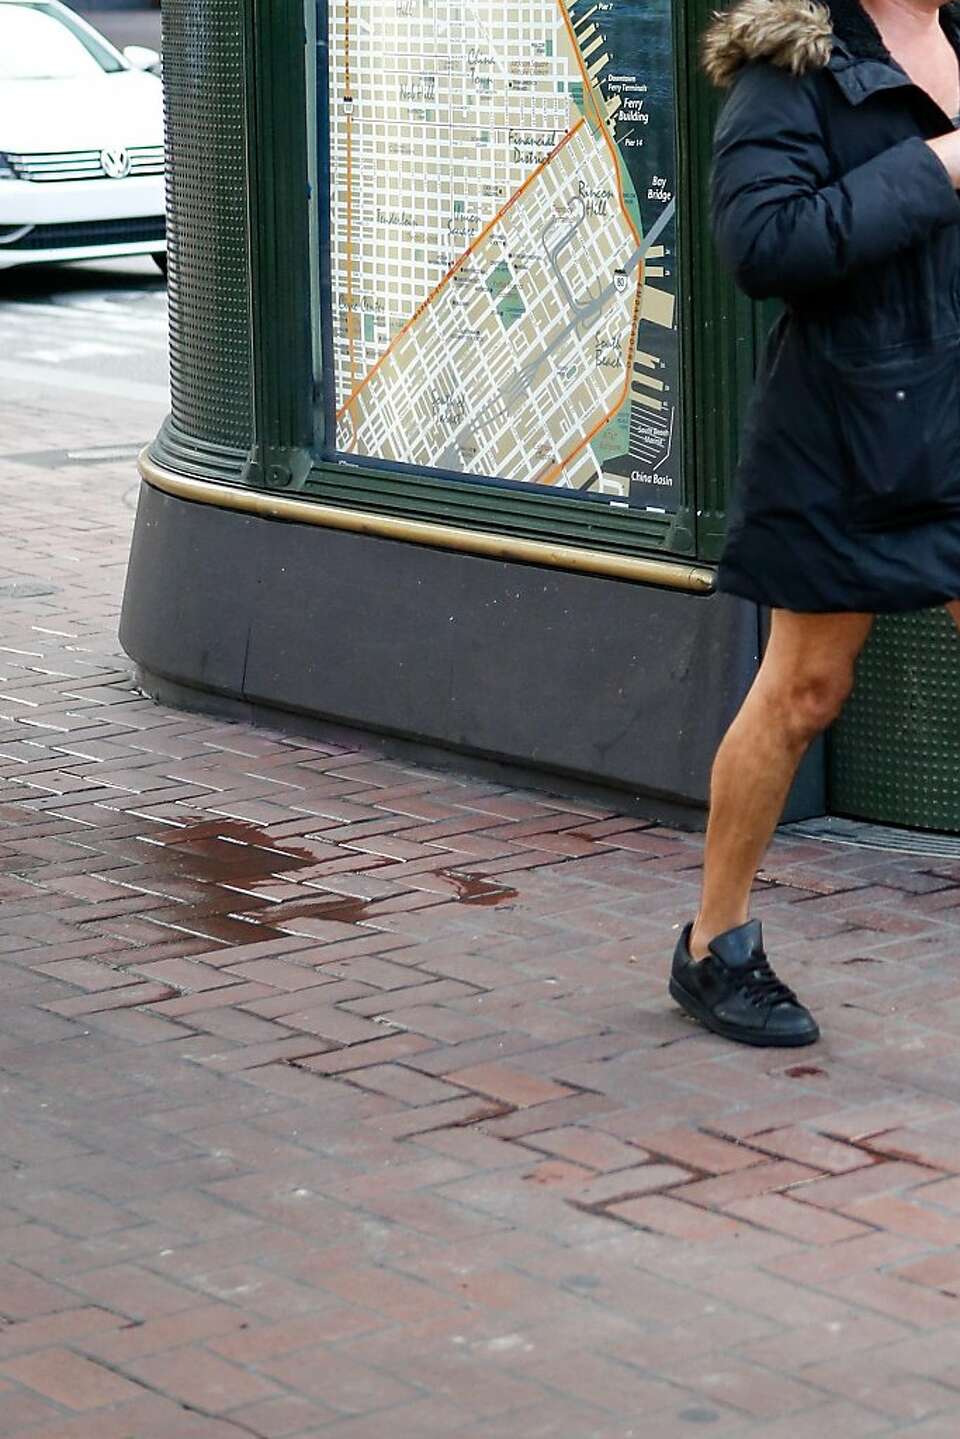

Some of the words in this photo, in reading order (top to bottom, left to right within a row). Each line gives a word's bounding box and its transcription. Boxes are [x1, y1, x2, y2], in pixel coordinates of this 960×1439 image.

[623, 98, 643, 112] Ferry
[618, 110, 649, 125] Building
[651, 175, 667, 187] Bay
[647, 189, 672, 203] Bridge
[631, 471, 652, 484] China
[653, 473, 673, 487] Basin
